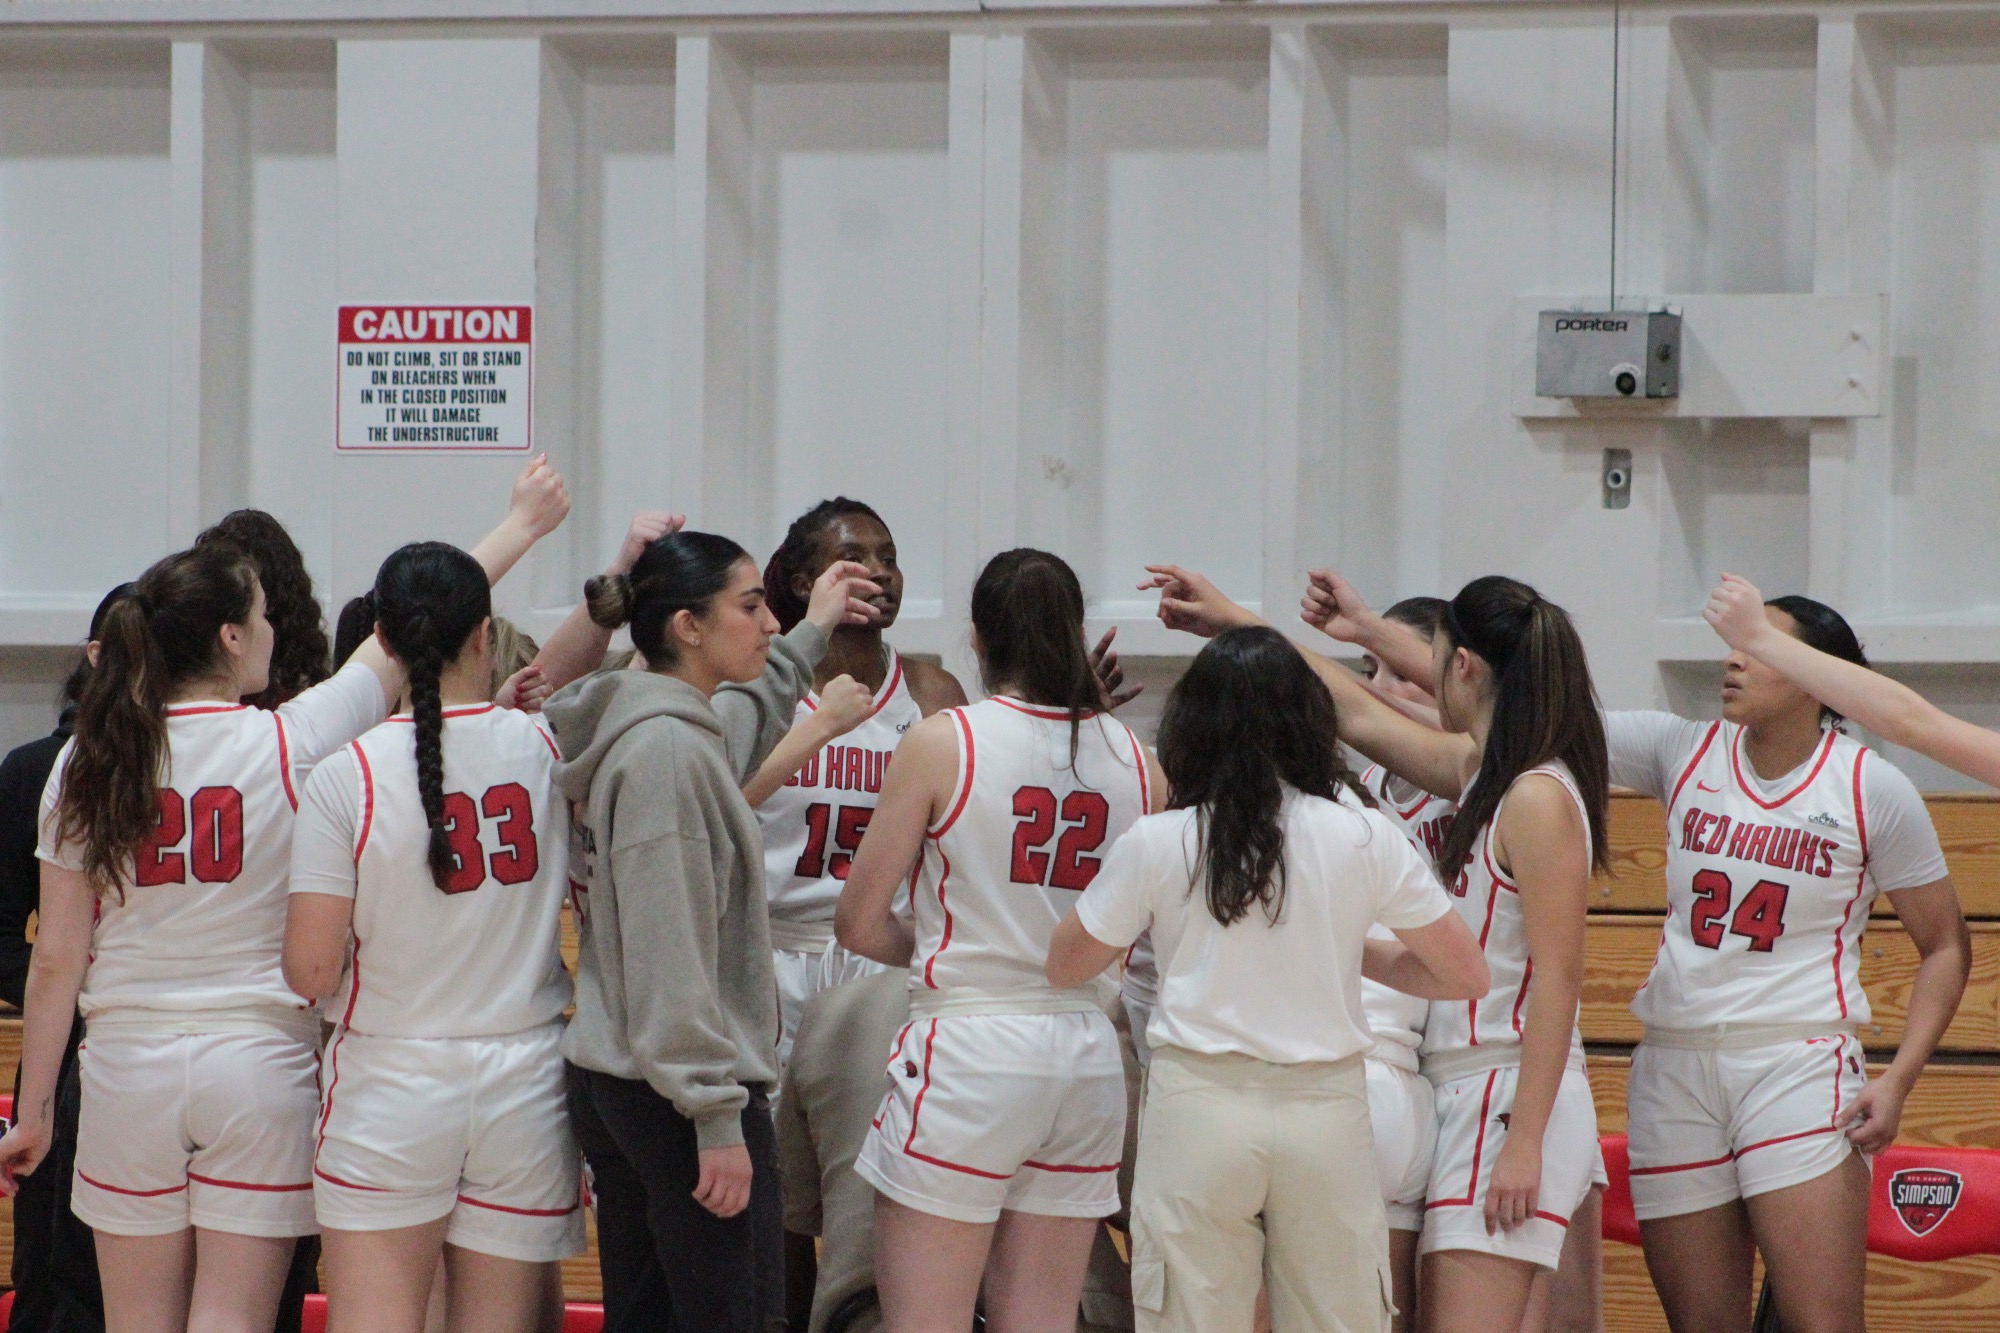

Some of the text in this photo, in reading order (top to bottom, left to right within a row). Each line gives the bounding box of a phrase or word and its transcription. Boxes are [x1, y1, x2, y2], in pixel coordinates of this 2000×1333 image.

[353, 309, 518, 340] CAUTION
[347, 351, 521, 368] DO NOT CLIMB, SIT OR STAND
[371, 370, 496, 385] ON BLEACHERS WHEN
[360, 389, 507, 404] IN THE CLOSED POSITION
[386, 408, 480, 423] IT WILL DAMAGE
[368, 427, 499, 442] THE UNDERSTRUCTURE
[135, 785, 244, 888] 20
[434, 781, 540, 895] 33
[794, 802, 875, 881] 15
[1009, 785, 1110, 892] 22
[1680, 807, 1840, 878] RED HAWKS
[1690, 868, 1790, 953] 24
[1896, 1184, 1953, 1205] SIMPSON
